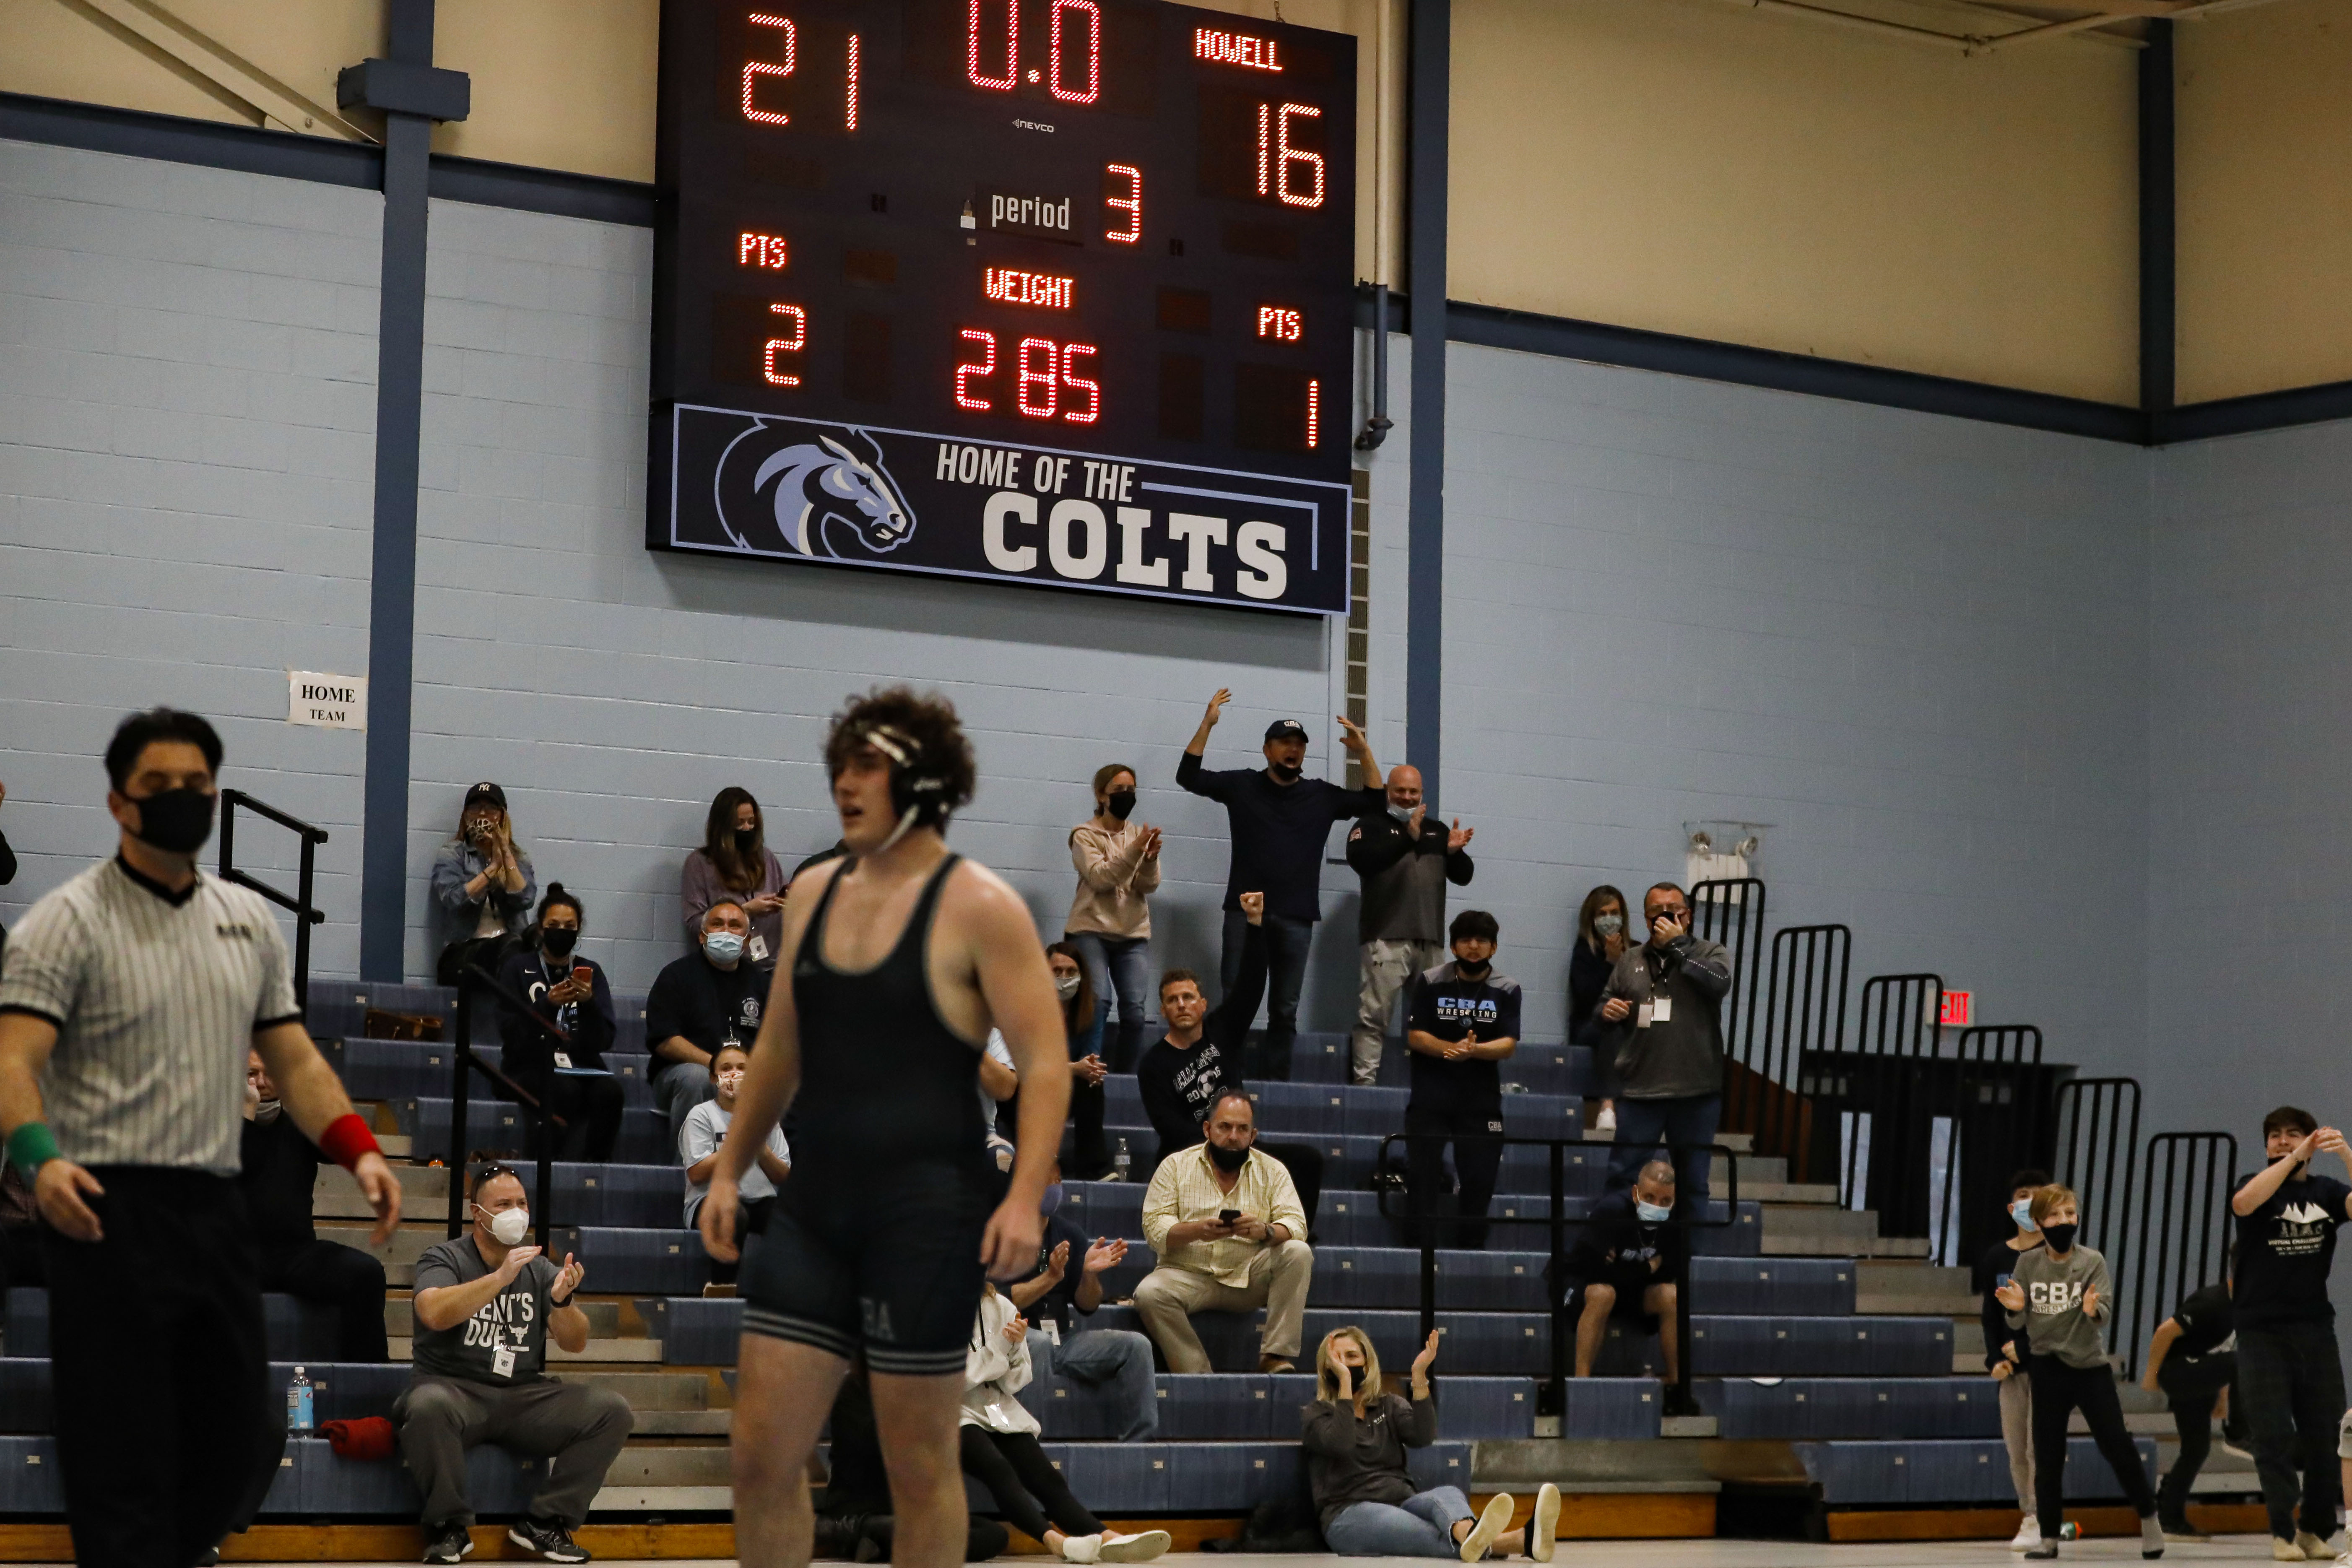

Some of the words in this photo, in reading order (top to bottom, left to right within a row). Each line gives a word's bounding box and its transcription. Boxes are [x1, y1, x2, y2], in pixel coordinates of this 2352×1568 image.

[968, 0, 1099, 104] 0.0
[1196, 28, 1283, 71] HOWELL
[742, 13, 859, 130] 21
[1019, 120, 1054, 133] NEVCO
[1259, 103, 1324, 207] 16
[992, 194, 1069, 230] period
[1107, 164, 1140, 242] 3
[741, 233, 785, 268] PTS
[986, 268, 1073, 308] WEIGHT
[1260, 307, 1299, 340] PTS
[764, 304, 805, 385] 2
[957, 330, 1098, 422] 285
[1308, 380, 1318, 447] 1
[936, 444, 1021, 489] HOME
[1034, 456, 1071, 494] OF
[1084, 461, 1135, 502] THE
[983, 491, 1287, 599] COLTS
[302, 685, 355, 703] HOME
[310, 709, 345, 721] TEAM
[1437, 997, 1497, 1012] CBA
[1941, 991, 1970, 1025] EXIT
[473, 1292, 534, 1322] ENT'S
[464, 1318, 506, 1348] DUE
